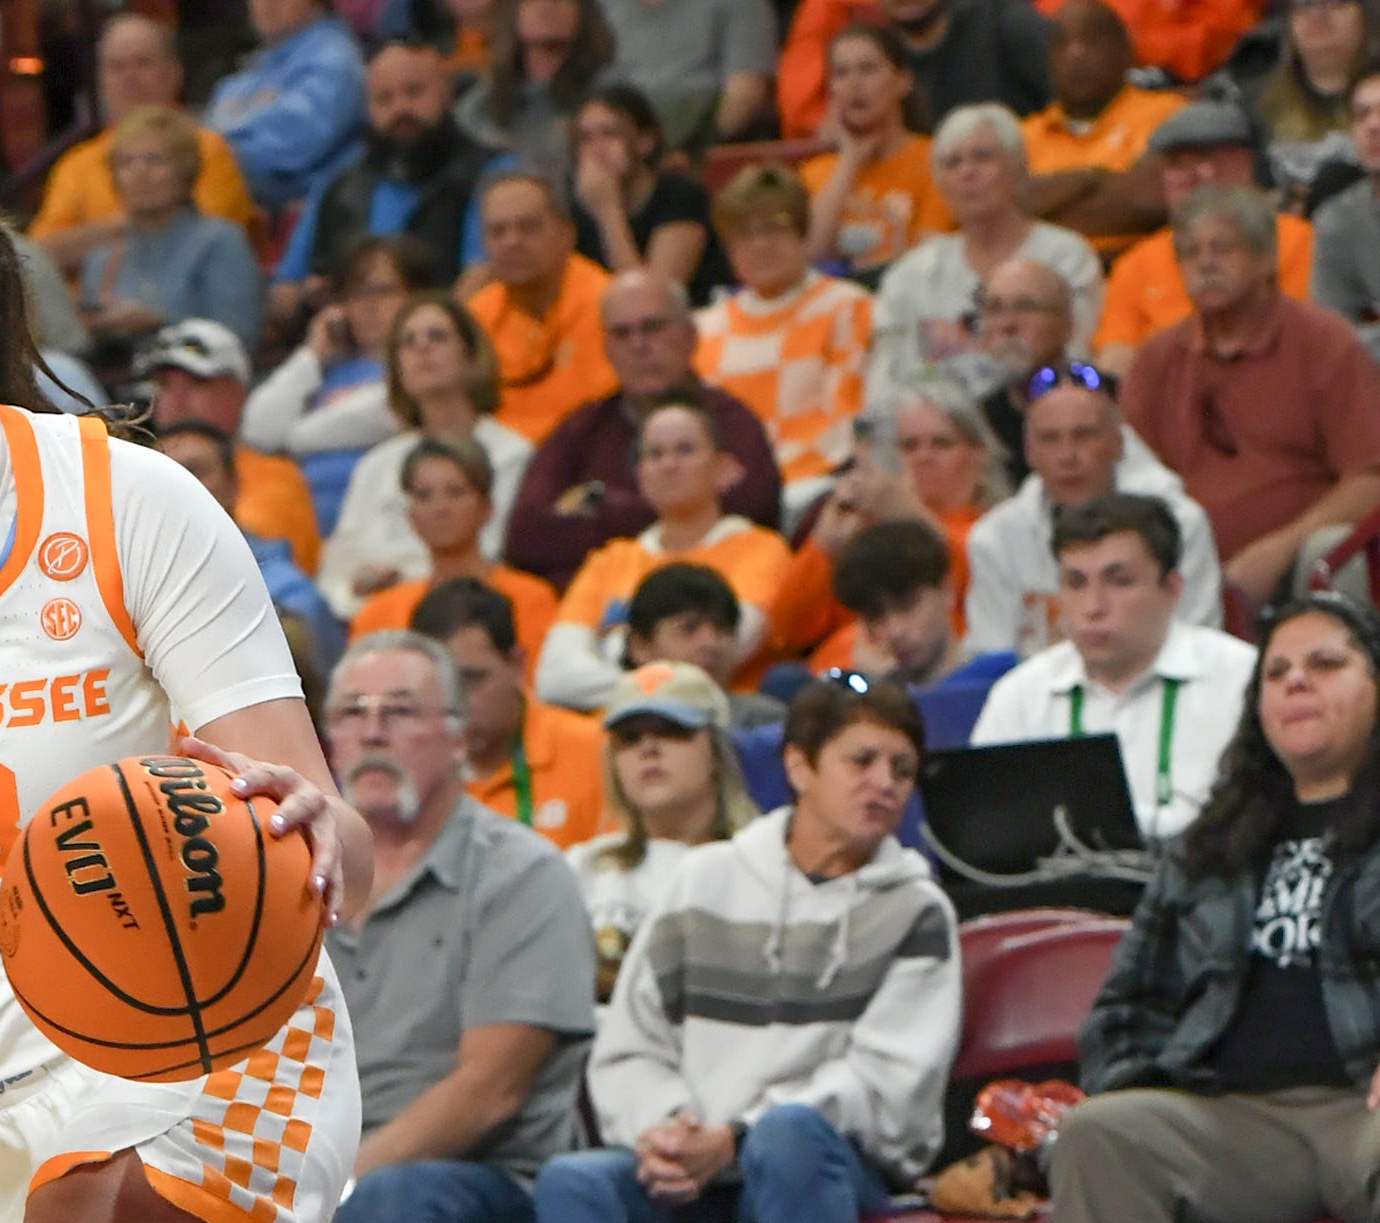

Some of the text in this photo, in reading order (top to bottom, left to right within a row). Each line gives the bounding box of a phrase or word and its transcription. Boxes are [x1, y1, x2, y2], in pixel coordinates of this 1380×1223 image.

[43, 600, 79, 637] SEC
[139, 756, 226, 924] Wilson
[107, 891, 140, 931] NXT
